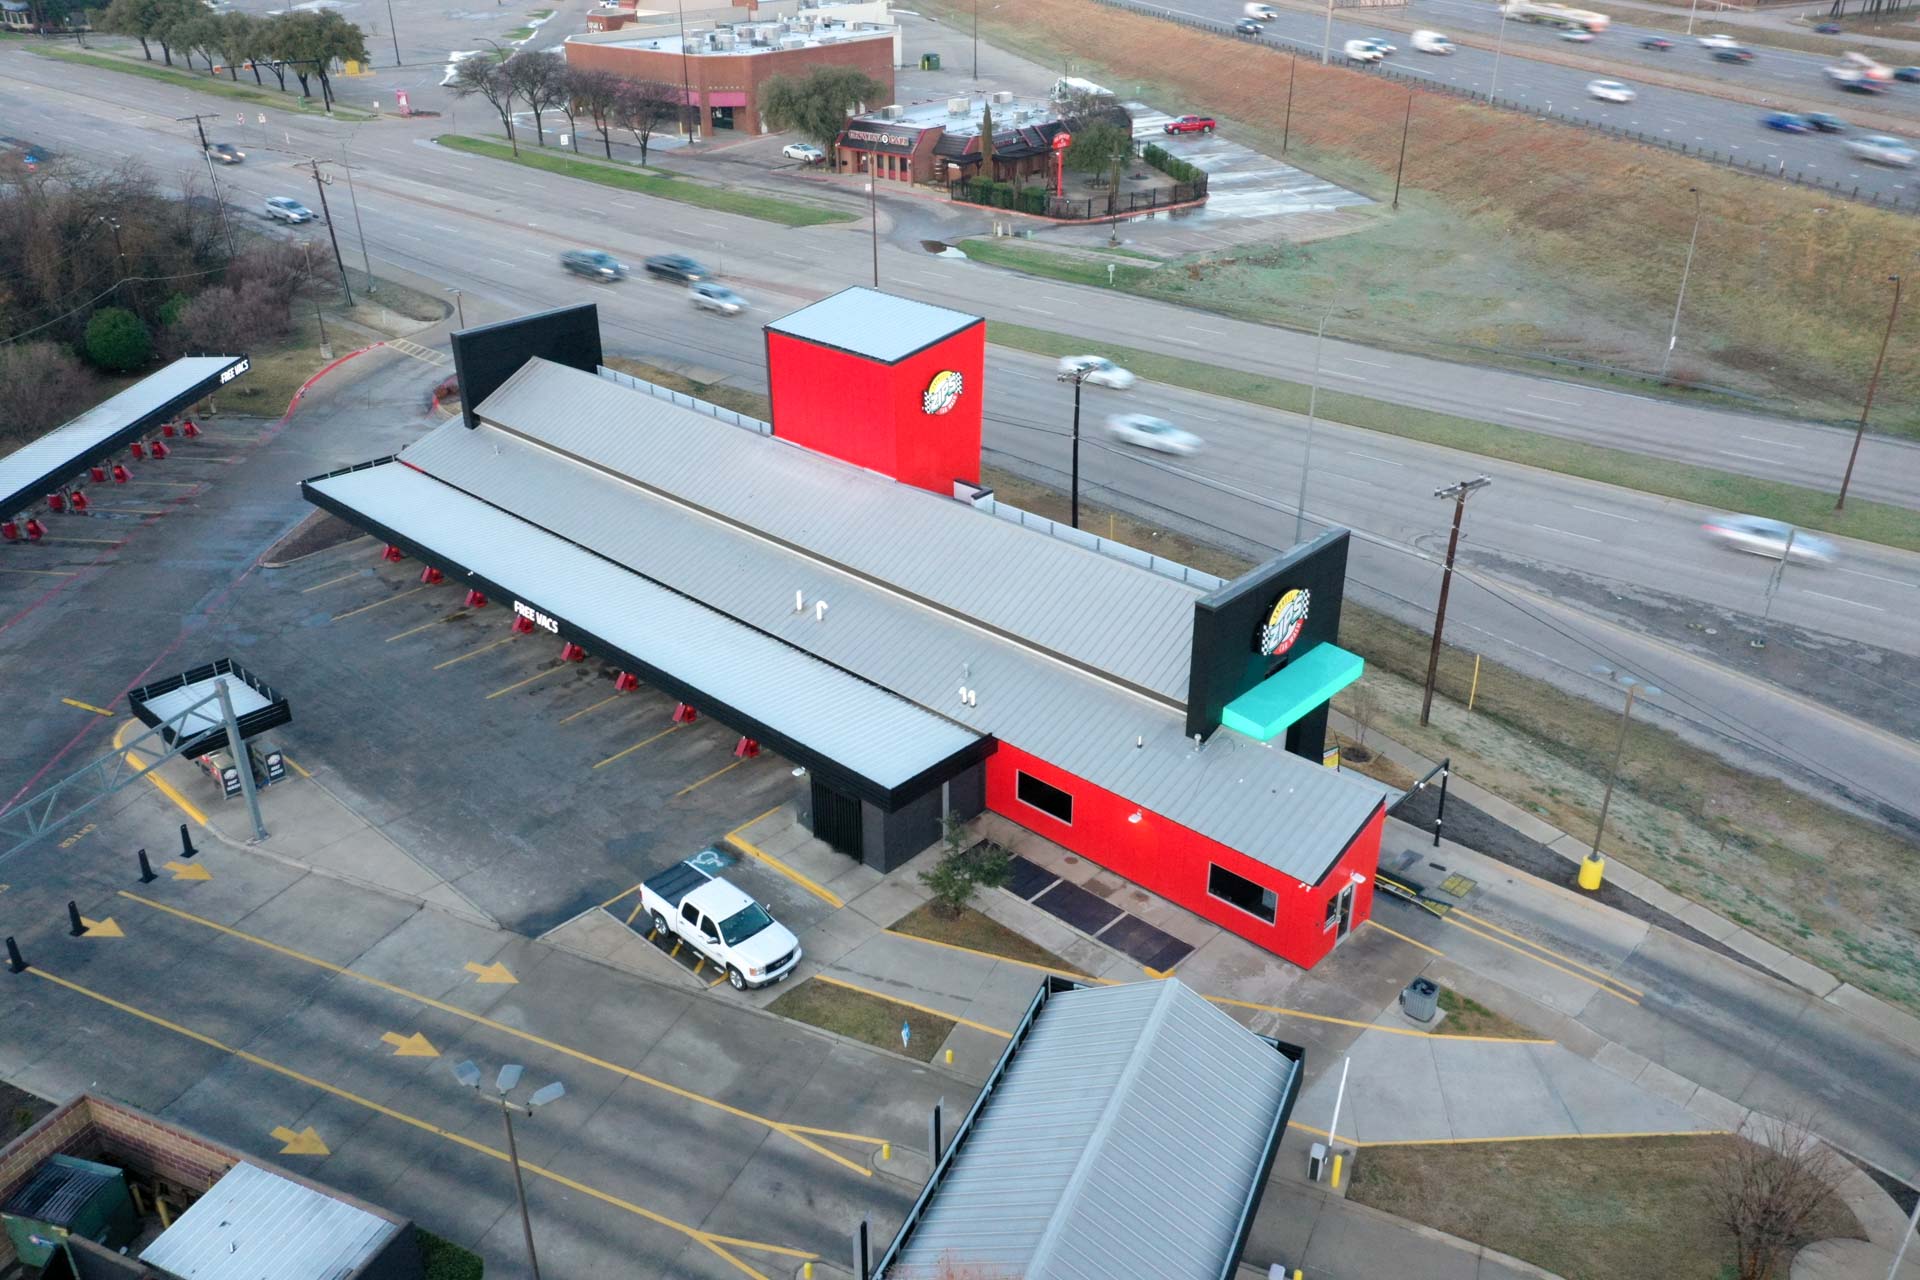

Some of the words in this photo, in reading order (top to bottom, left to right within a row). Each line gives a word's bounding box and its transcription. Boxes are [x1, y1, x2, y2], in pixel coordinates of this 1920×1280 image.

[221, 367, 235, 384] FREE
[514, 600, 535, 621] FREE
[535, 612, 558, 633] VACS
